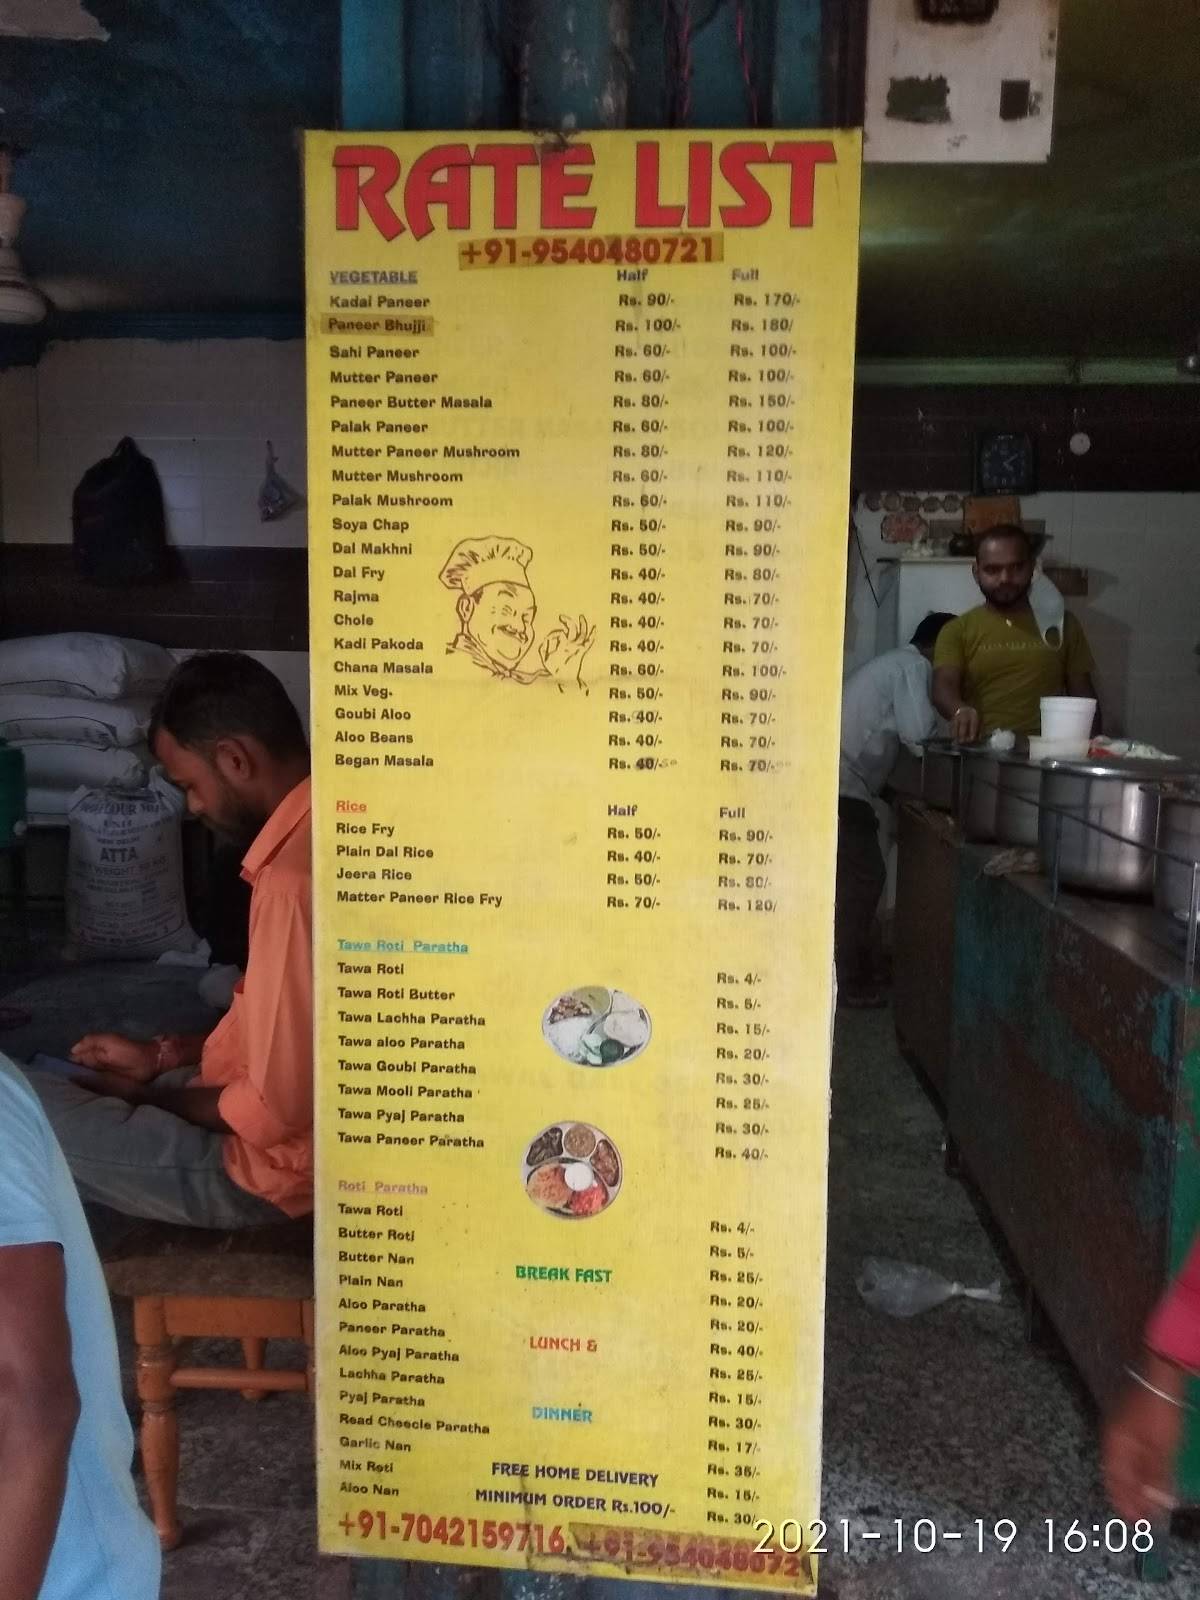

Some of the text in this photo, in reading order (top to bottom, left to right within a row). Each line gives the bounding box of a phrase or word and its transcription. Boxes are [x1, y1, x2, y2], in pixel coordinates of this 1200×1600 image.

[332, 140, 838, 242] RATE LIST
[461, 238, 717, 265] +91-9540480721
[330, 270, 418, 285] VEGETABLE
[617, 269, 648, 282] Half
[732, 268, 759, 281] Full
[330, 295, 430, 308] Kadai Paneer
[619, 293, 674, 308] Rs. 90/-
[734, 293, 757, 306] Rs.
[329, 316, 427, 335] Paneer Bhujji
[330, 345, 420, 359] Sahi Paneer
[330, 371, 438, 384] Mutter Paneer
[331, 395, 493, 409] Paneer Butter Masala
[613, 395, 636, 408] Rs.
[331, 420, 428, 433] Palak Paneer
[332, 444, 520, 458] Mutter Paneer Mushroom
[332, 469, 463, 482] Mutter Mushroom
[332, 493, 453, 507] Palak Mushroom
[332, 517, 409, 534] Soya Chap
[332, 542, 412, 555] Dal Makhni
[333, 566, 385, 582] Dal Fry
[611, 567, 665, 581] Rs. 40/-
[334, 589, 380, 606] Rajma
[333, 613, 374, 626] Chole
[334, 637, 424, 650] Kadi Pakoda
[333, 660, 433, 674] Chana Masala
[610, 663, 664, 677] Rs. 60/-
[334, 684, 393, 700] Mix Veg.
[609, 687, 663, 700] Rs. 50/-
[335, 707, 411, 720] Goubi Aloo
[334, 730, 414, 744] Aloo Beans
[335, 753, 434, 769] Began Masala
[336, 800, 367, 813] Rice
[608, 804, 638, 817] Half
[719, 806, 745, 819] Full
[336, 822, 395, 838] Rice Fry
[607, 827, 629, 840] Rs.
[719, 829, 773, 843] Rs. 90/-
[100, 847, 139, 862] ATTA
[336, 845, 434, 858] Plain Dal Rice
[336, 867, 412, 881] Jeera Rice
[337, 890, 502, 908] Matter Paneer Rice Fry
[374, 939, 405, 953] Roti
[411, 940, 469, 955] Paratha
[337, 961, 404, 975] Tawa Roti
[337, 986, 455, 1001] Tawa Roti Butter
[337, 1010, 486, 1026] Tawa Lachha Paratha
[716, 1022, 739, 1035] Rs.
[338, 1035, 465, 1050] Tawa aloo Paratha
[338, 1059, 476, 1075] Tawa Goubi Paratha
[338, 1083, 472, 1099] Tawa Mooli Paratha
[337, 1107, 464, 1124] Tawa Pyaj Paratha
[337, 1131, 485, 1148] Tawa Paneer Paratha
[339, 1180, 428, 1194] Roti Paratha
[337, 1203, 403, 1217] Tawa Roti
[338, 1227, 415, 1242] Butter Roti
[339, 1250, 415, 1265] Butter Nan
[339, 1274, 403, 1288] Plain Nan
[515, 1264, 613, 1285] BREAK FAST
[338, 1297, 426, 1313] Aloo Paratha
[339, 1321, 446, 1337] Paneer Paratha
[339, 1344, 460, 1362] Aloo Pyaj Paratha
[529, 1337, 597, 1354] LUNCH &
[710, 1343, 763, 1358] Rs. 40/-
[339, 1367, 446, 1385] Lachha Paratha
[339, 1390, 425, 1407] Pyaj Paratha
[532, 1407, 593, 1425] DINNER
[708, 1415, 761, 1431] Rs. 30/-
[339, 1413, 373, 1425] Read
[436, 1420, 490, 1435] Paratha
[339, 1436, 411, 1452] Garlic Nan
[340, 1460, 393, 1474] Mix Roti
[491, 1462, 659, 1488] FREE HOME DELIVERY
[340, 1481, 399, 1496] Aloo Nan
[476, 1489, 675, 1518] MINIMUM ORDER Rs.100/-
